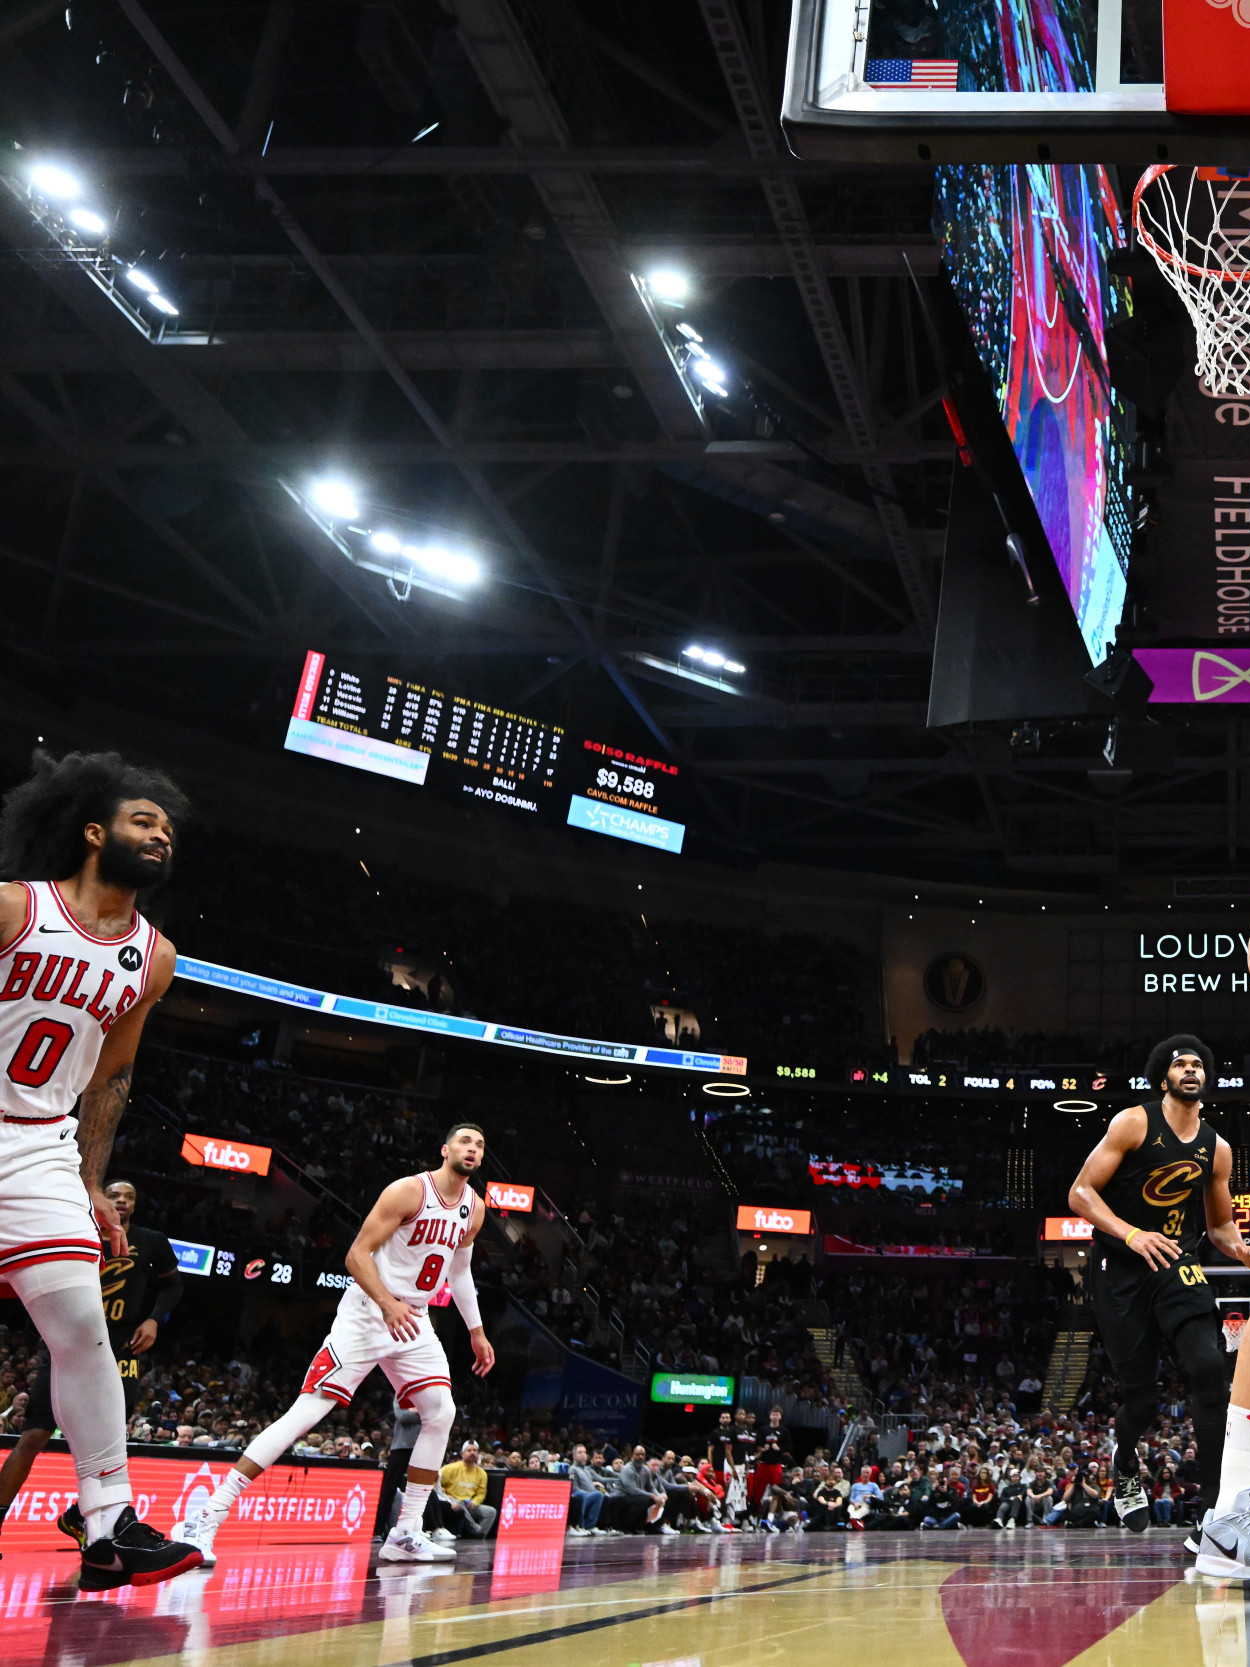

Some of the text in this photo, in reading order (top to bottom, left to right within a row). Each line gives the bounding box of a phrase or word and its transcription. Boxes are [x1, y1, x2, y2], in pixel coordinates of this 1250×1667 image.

[317, 716, 367, 736] TEAM TOTALS
[625, 752, 679, 776] RAFFLE
[474, 787, 494, 800] AYO
[596, 767, 655, 799] $9,588
[609, 814, 670, 840] CHAMPS
[184, 962, 210, 979] Taking
[211, 971, 229, 982] care
[230, 975, 240, 983] of
[240, 978, 258, 989] your
[258, 983, 278, 993] team
[278, 988, 295, 998] and
[1144, 973, 1221, 993] BREW
[389, 1010, 448, 1029] Cleveland Clinic
[6, 1017, 75, 1089] 0
[501, 1030, 525, 1043] Official
[563, 1041, 592, 1054] Provider
[592, 1044, 601, 1054] of
[601, 1046, 612, 1055] the
[776, 1065, 816, 1079] $9,588
[872, 1071, 888, 1083] +4
[909, 1073, 931, 1085] TOL
[938, 1075, 947, 1087] 2
[963, 1076, 999, 1088] FOULS
[1005, 1079, 1015, 1090] 4
[1030, 1079, 1055, 1090] FG%
[1061, 1078, 1077, 1090] 52
[1217, 1077, 1244, 1089] 2:43
[204, 1141, 250, 1170] fubo
[490, 1186, 530, 1209] fubo
[754, 1210, 793, 1230] fubo
[1162, 1209, 1186, 1236] 31
[217, 1250, 236, 1262] FG%
[215, 1262, 232, 1276] 52
[270, 1262, 293, 1284] 28
[415, 1253, 445, 1291] 8
[563, 1393, 638, 1408] LECOM
[670, 1380, 728, 1400] Huntington
[238, 1497, 336, 1521] WESTFIELD
[517, 1503, 565, 1520] WESTFIELD
